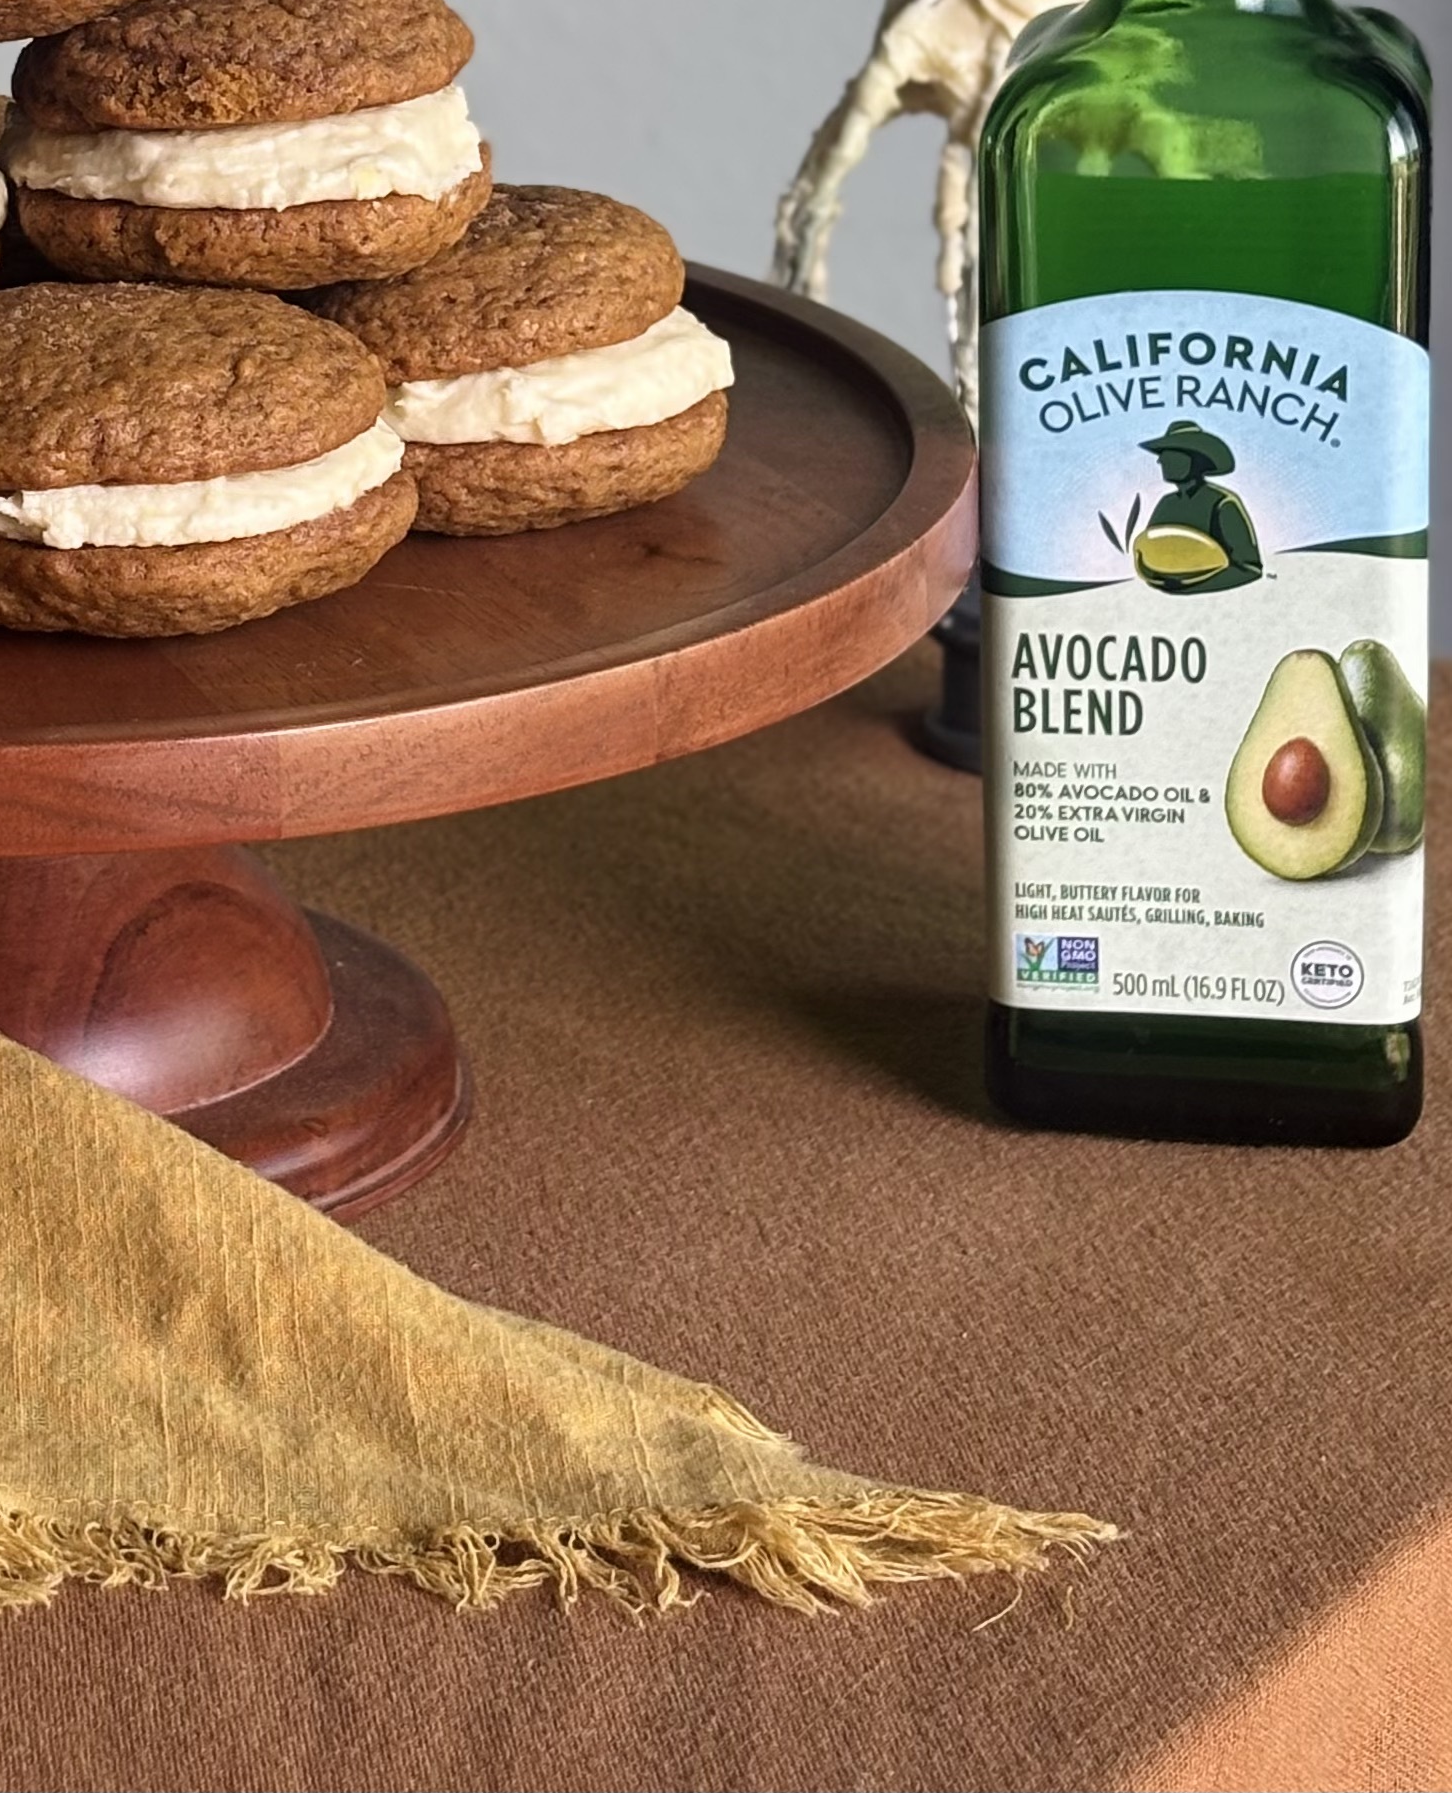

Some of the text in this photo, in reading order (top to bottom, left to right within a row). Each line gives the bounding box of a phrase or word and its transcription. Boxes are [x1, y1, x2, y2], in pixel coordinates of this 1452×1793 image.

[1019, 332, 1348, 403] CALIFORNIA
[1039, 375, 1165, 434] OLIVE
[1011, 633, 1207, 684] AVOCADO
[1013, 687, 1143, 735] BLEND
[1013, 761, 1117, 779] MADE WITH
[1013, 783, 1210, 803] 80% AVOCADO OIL &
[1013, 804, 1185, 823] 20% EXTRA VIRGIN
[1013, 825, 1105, 843] OLIVE OIL
[1015, 883, 1200, 903] LIGHT, BUTTERY FLAVOR FOR
[1015, 904, 1264, 928] HIGH HEAT SAUTÉS, GRILLING, BAKING
[1061, 939, 1095, 950] NON
[1061, 949, 1096, 961] GMO
[1021, 971, 1096, 983] VERIFIED
[1301, 962, 1354, 978] KETO
[1113, 973, 1147, 996] 500
[1152, 975, 1180, 998] mL
[1183, 975, 1226, 1001] (16.9
